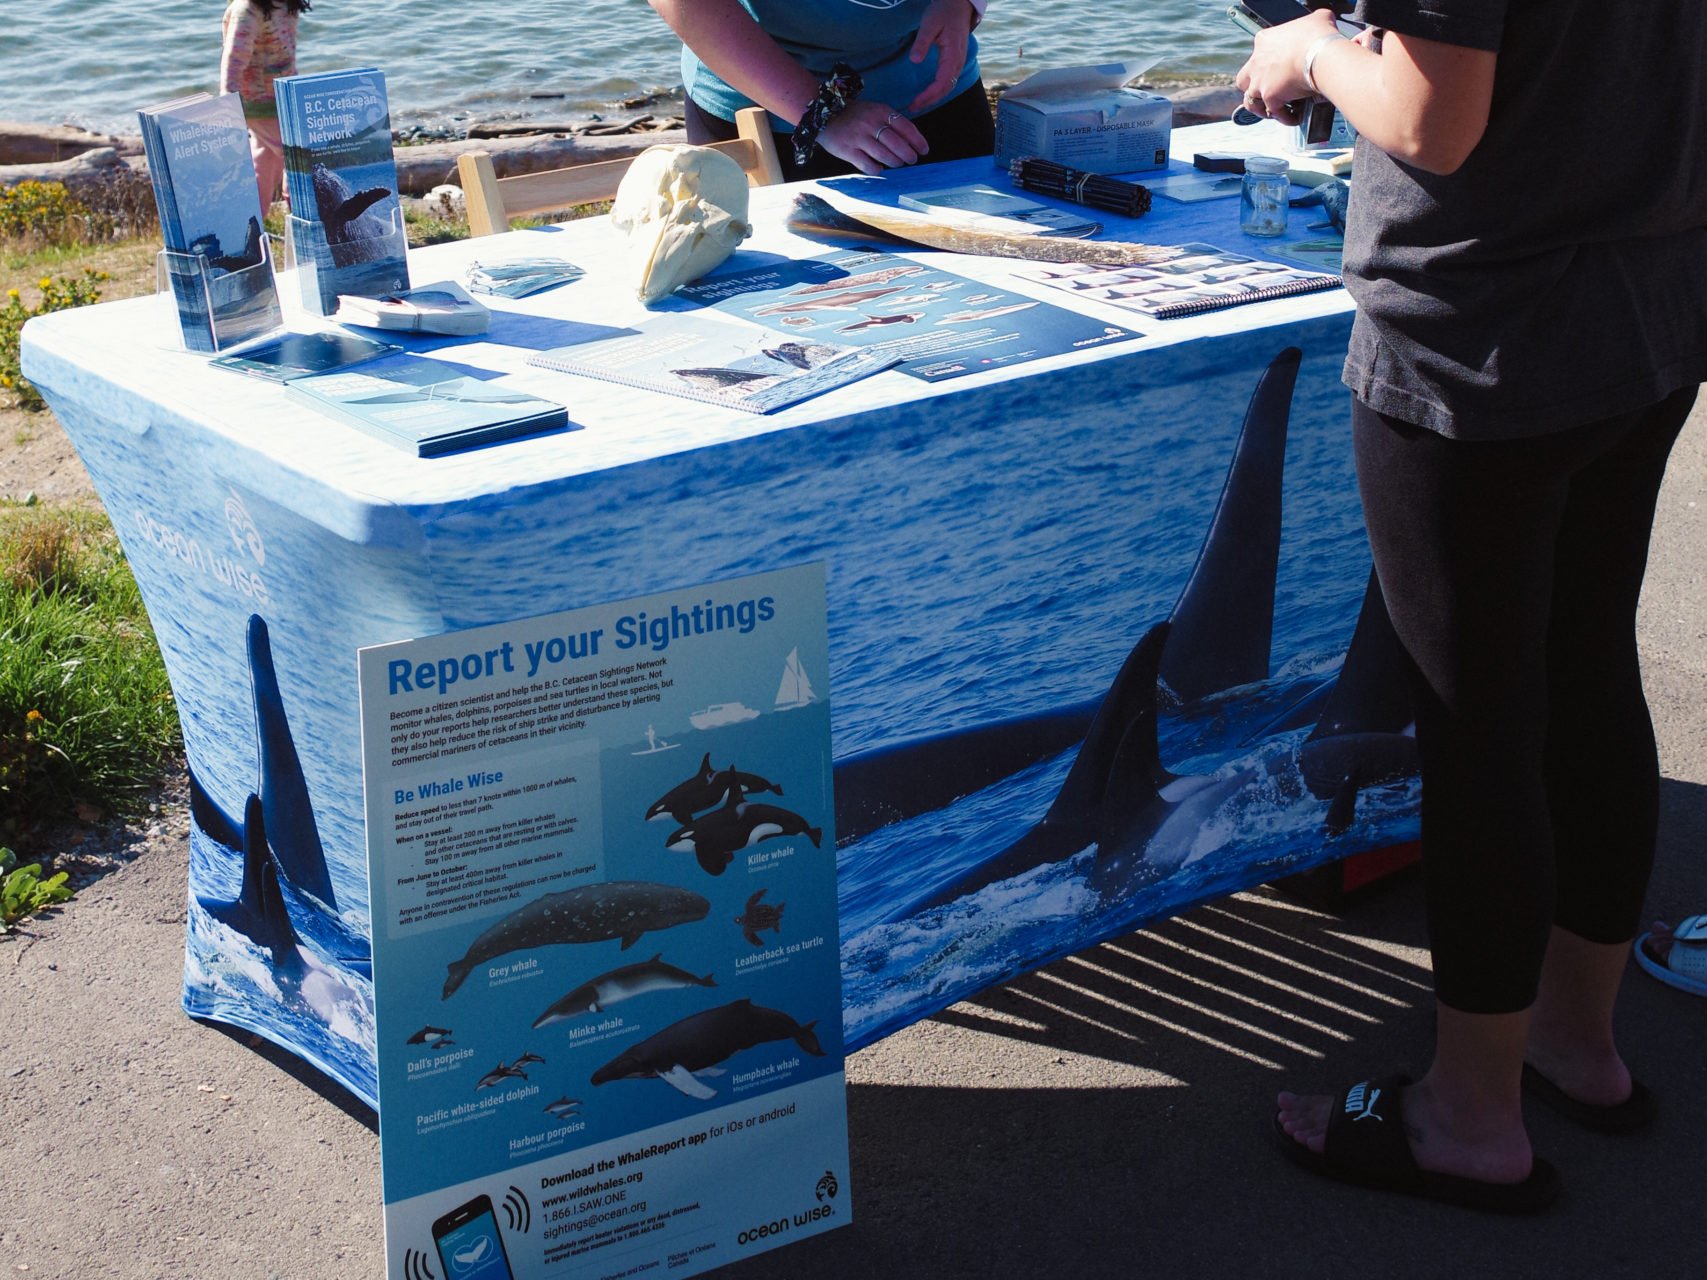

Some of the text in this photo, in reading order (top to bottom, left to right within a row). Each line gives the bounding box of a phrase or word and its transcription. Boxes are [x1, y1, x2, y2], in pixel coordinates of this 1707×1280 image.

[305, 95, 377, 114] B.C. Cetacean
[169, 120, 233, 144] WhaleReport
[306, 113, 355, 130] Sightings
[1053, 128, 1063, 137] PA
[1069, 126, 1092, 136] LAYER
[1097, 122, 1135, 133] DISPOSABLE
[1136, 120, 1154, 128] MASK
[174, 135, 235, 161] Alert System
[308, 128, 353, 144] Network
[743, 271, 781, 284] your
[135, 510, 269, 605] ocean wise
[388, 597, 773, 694] Report your Sightings
[389, 657, 666, 720] Become a citizen scientist and help the B.C. Cetacean Sightings Network
[390, 669, 662, 731] monitor whales, dolphins, porpoises and sea turtles in local waters. Not
[390, 678, 673, 743] only do your reports help researchers better understand these species, but
[391, 693, 660, 755] they also help reduce the risk of ship strike and disturbance by alerting
[391, 720, 586, 766] commercial mariners of cetaceans in their vicinity.
[394, 771, 502, 804] Be Whale Wise
[394, 811, 419, 821] Reduce
[420, 804, 440, 816] speed
[448, 801, 462, 809] less
[462, 798, 477, 806] than
[483, 793, 501, 801] knots
[502, 788, 521, 797] within
[522, 783, 538, 792] 1000
[395, 820, 407, 830] and
[408, 819, 422, 827] stay
[422, 816, 434, 824] out
[442, 810, 457, 820] their
[458, 805, 476, 816] travel
[395, 835, 414, 844] When
[429, 826, 452, 836] vessel:
[747, 845, 794, 865] Killer whale
[397, 876, 414, 885] From
[415, 872, 431, 881] June
[440, 864, 467, 875] October:
[398, 905, 423, 916] Anyone
[430, 893, 474, 908] contravention
[482, 887, 501, 896] these
[501, 879, 536, 892] regulations
[536, 876, 548, 884] can
[548, 872, 562, 880] now
[571, 863, 596, 875] charged
[735, 946, 784, 967] Leatherback
[785, 943, 800, 953] sea
[801, 936, 823, 949] turtle
[488, 965, 509, 980] Grey
[511, 957, 537, 972] whale
[568, 1024, 596, 1039] Minke
[597, 1016, 623, 1031] whale
[433, 1048, 473, 1068] porpoise
[732, 1064, 774, 1084] Humpback
[776, 1057, 799, 1071] whale
[416, 1109, 448, 1125] Pacific
[450, 1092, 504, 1116] white-sided
[505, 1084, 539, 1101] dolphin
[508, 1132, 544, 1150] Harbour
[546, 1121, 585, 1141] porpoise
[540, 1163, 594, 1189] Download
[596, 1159, 615, 1172] the
[617, 1137, 685, 1165] WhaleReport
[687, 1132, 707, 1145] app
[709, 1126, 724, 1138] for
[745, 1116, 755, 1127] or
[758, 1102, 795, 1123] android
[542, 1172, 642, 1207] www.wildwhales.org
[543, 1201, 646, 1239] sightings@ocean.org
[737, 1218, 789, 1245] ocean
